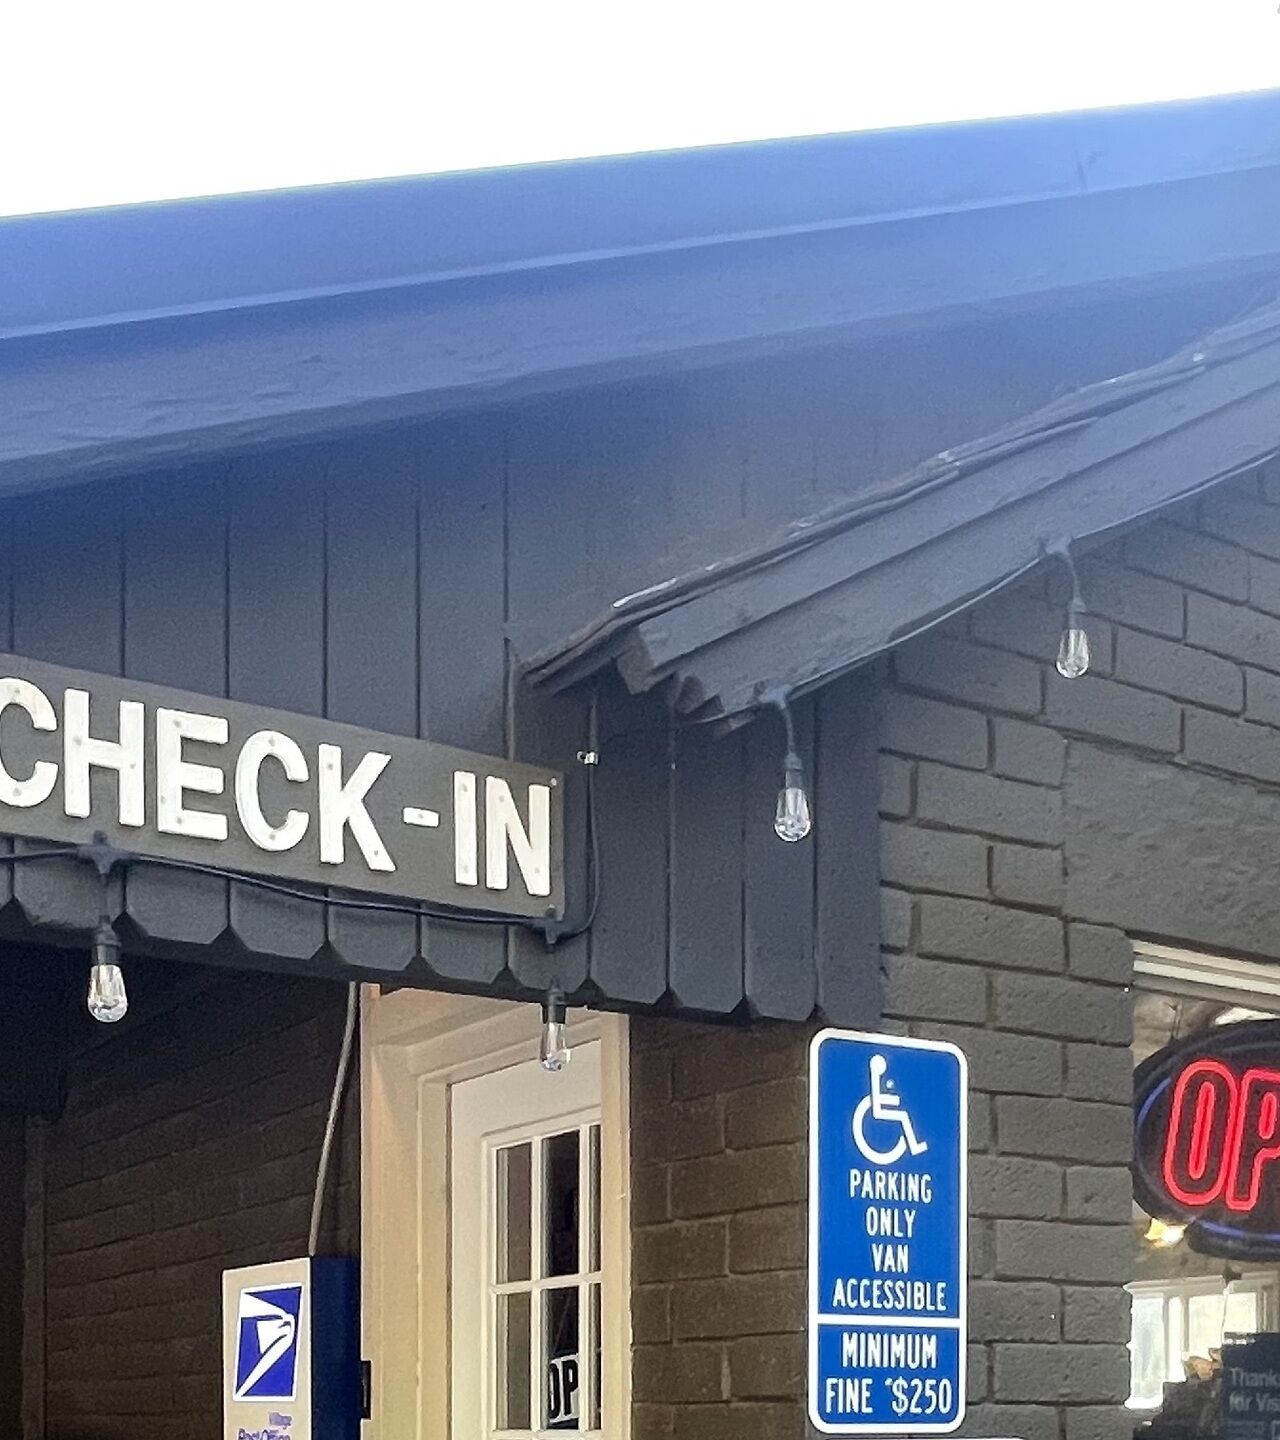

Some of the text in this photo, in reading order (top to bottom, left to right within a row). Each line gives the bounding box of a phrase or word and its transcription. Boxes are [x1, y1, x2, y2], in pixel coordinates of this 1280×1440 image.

[849, 1168, 933, 1204] PARKING
[865, 1206, 916, 1238] ONLY
[871, 1243, 909, 1274] VAN
[832, 1278, 947, 1311] ACCESSIBLE
[842, 1332, 937, 1369] MINIMUM
[825, 1375, 952, 1417] FINE $250
